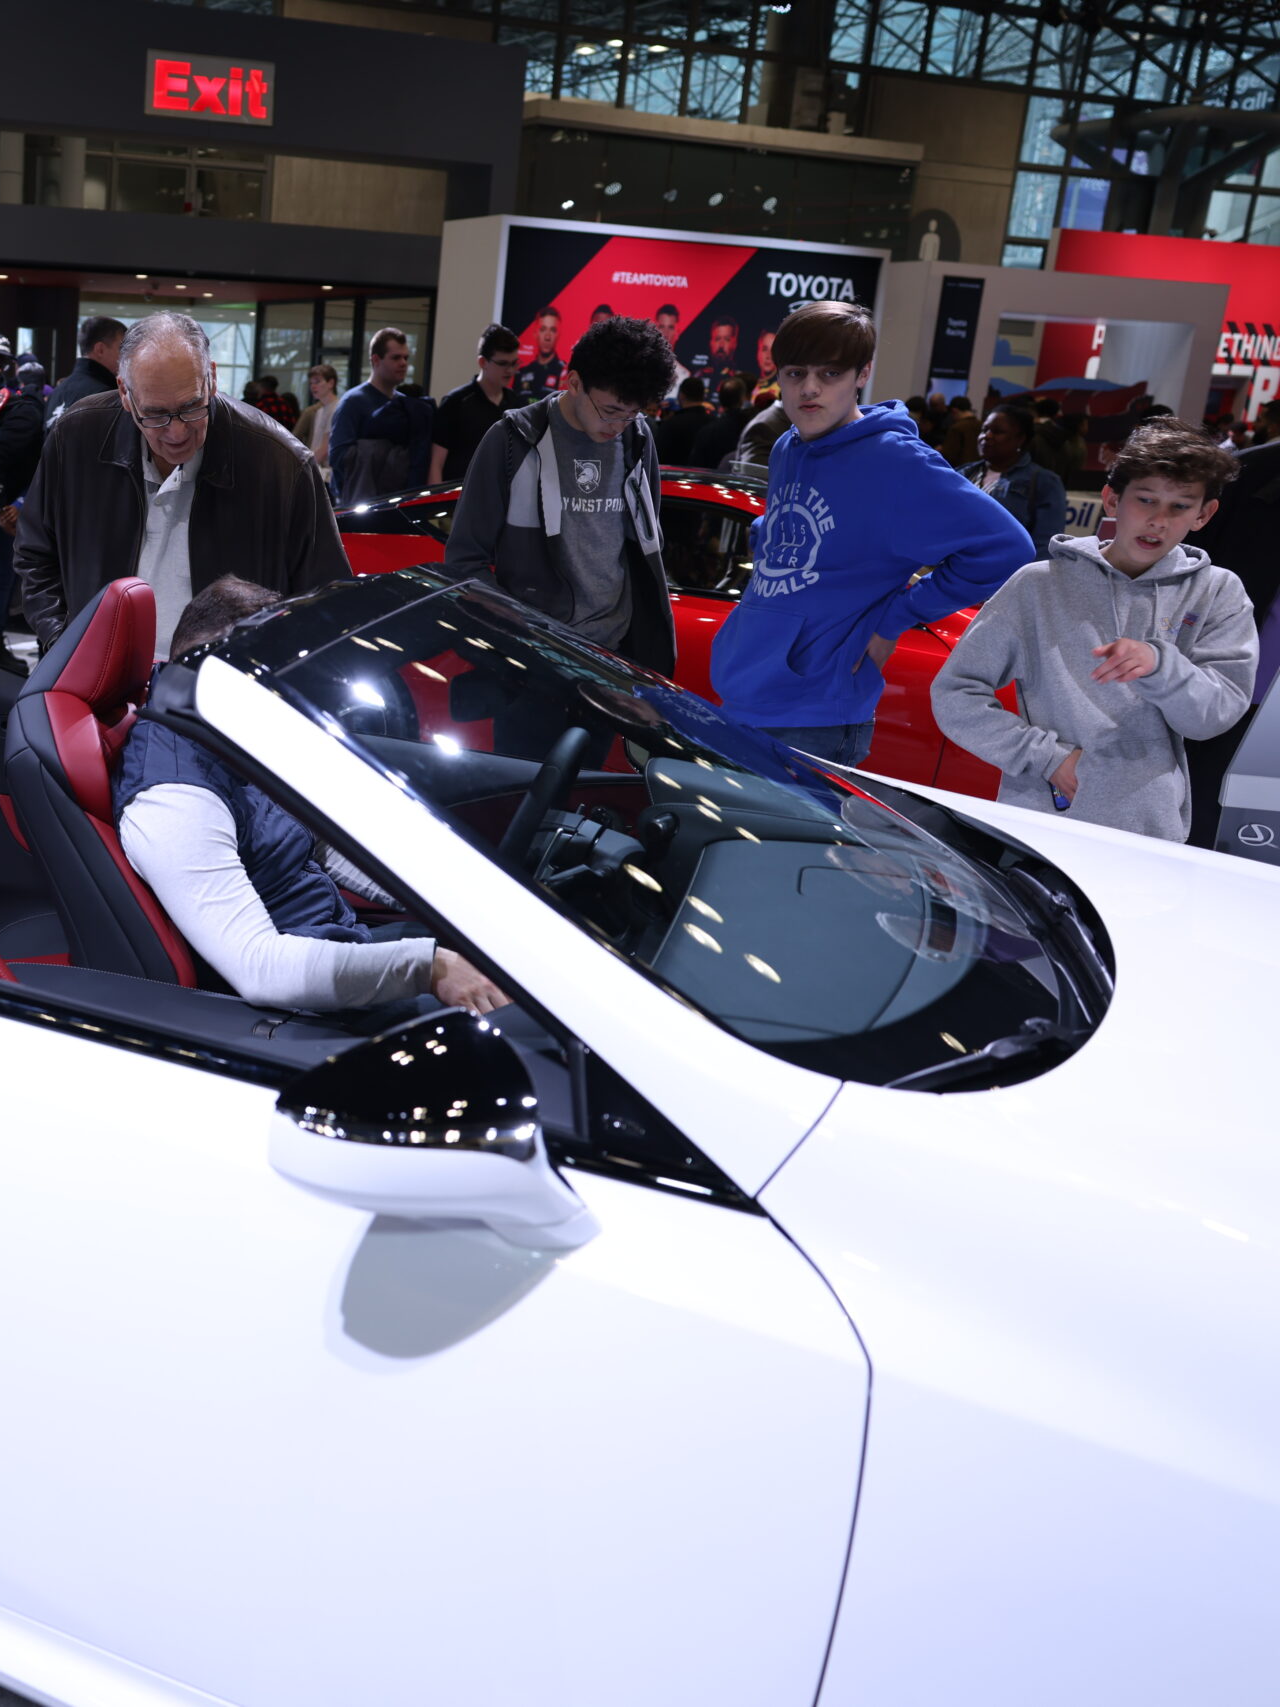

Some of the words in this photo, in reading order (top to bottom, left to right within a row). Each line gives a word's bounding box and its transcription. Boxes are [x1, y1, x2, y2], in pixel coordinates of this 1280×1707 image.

[153, 59, 268, 119] Exit
[612, 271, 689, 288] #TEAMTOYOTA
[767, 271, 855, 301] TOYOTA
[571, 498, 603, 513] WEST
[805, 487, 836, 535] THE
